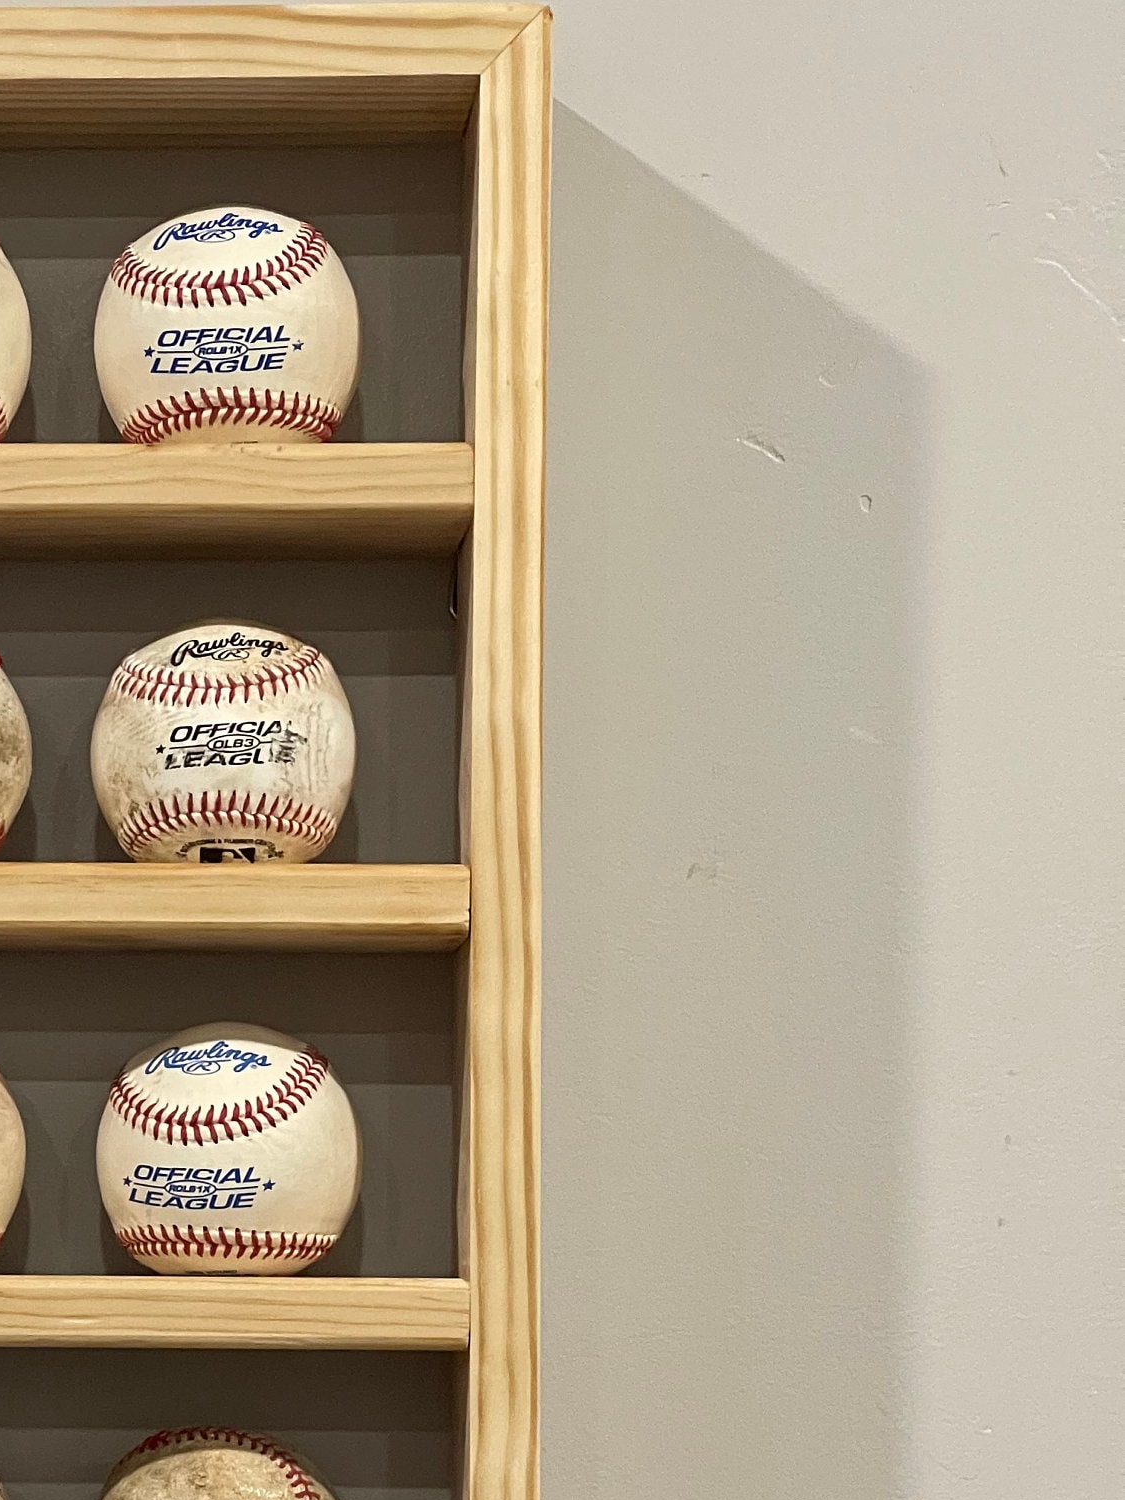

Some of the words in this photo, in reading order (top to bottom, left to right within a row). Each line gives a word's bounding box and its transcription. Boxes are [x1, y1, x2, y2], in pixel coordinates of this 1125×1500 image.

[153, 213, 283, 250] Rawlings
[157, 325, 290, 347] OFFICIAL
[150, 352, 287, 374] LEAGUE
[171, 632, 288, 666] Rawlings
[213, 740, 254, 749] OLB3
[145, 1041, 271, 1074] Rawlings
[134, 1165, 260, 1183] OFFICIAL
[129, 1188, 257, 1210] LEAGUE
